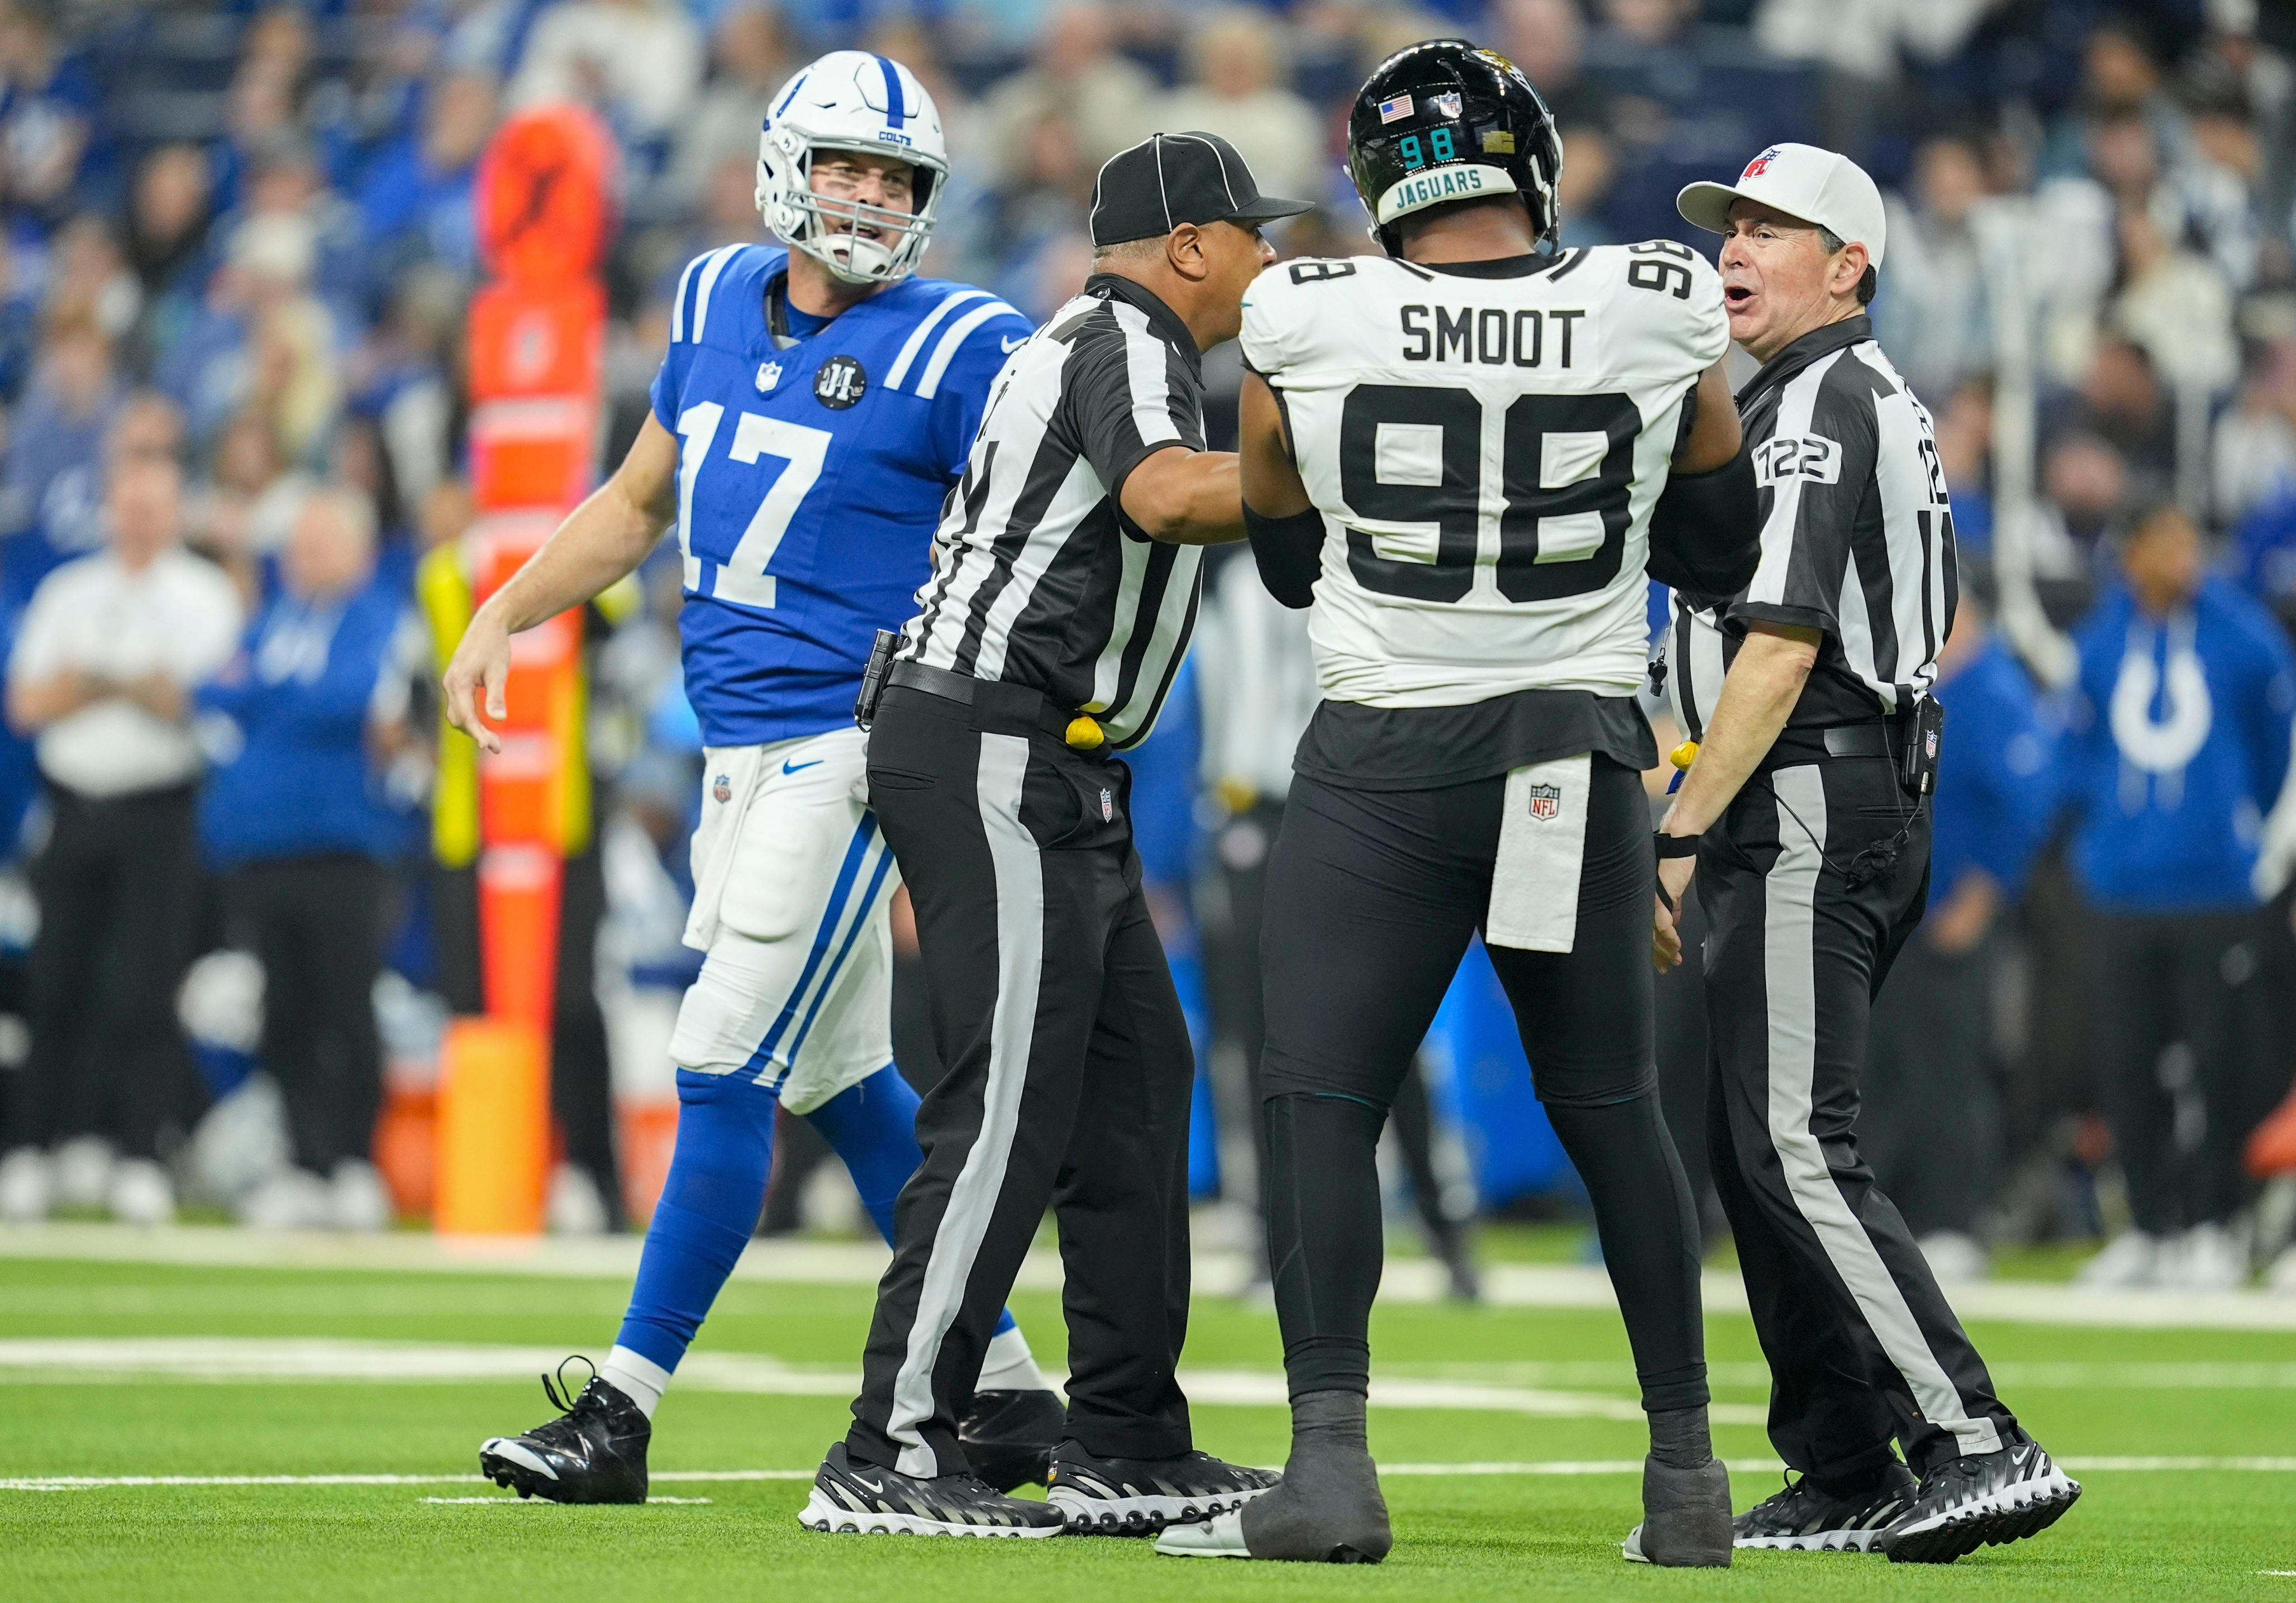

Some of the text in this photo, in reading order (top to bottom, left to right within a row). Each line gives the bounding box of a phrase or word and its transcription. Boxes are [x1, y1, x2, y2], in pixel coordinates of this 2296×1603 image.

[879, 131, 911, 146] COLTS
[1399, 127, 1455, 169] 98
[1397, 169, 1483, 209] JAGUARS
[1288, 257, 1356, 285] 8
[1628, 242, 1693, 300] 98
[1401, 304, 1585, 369] SMOOT
[1757, 438, 1830, 480] 122
[1918, 439, 1949, 504] 12
[677, 401, 833, 609] 17
[1341, 383, 1643, 603] 98
[1533, 799, 1555, 816] NFL
